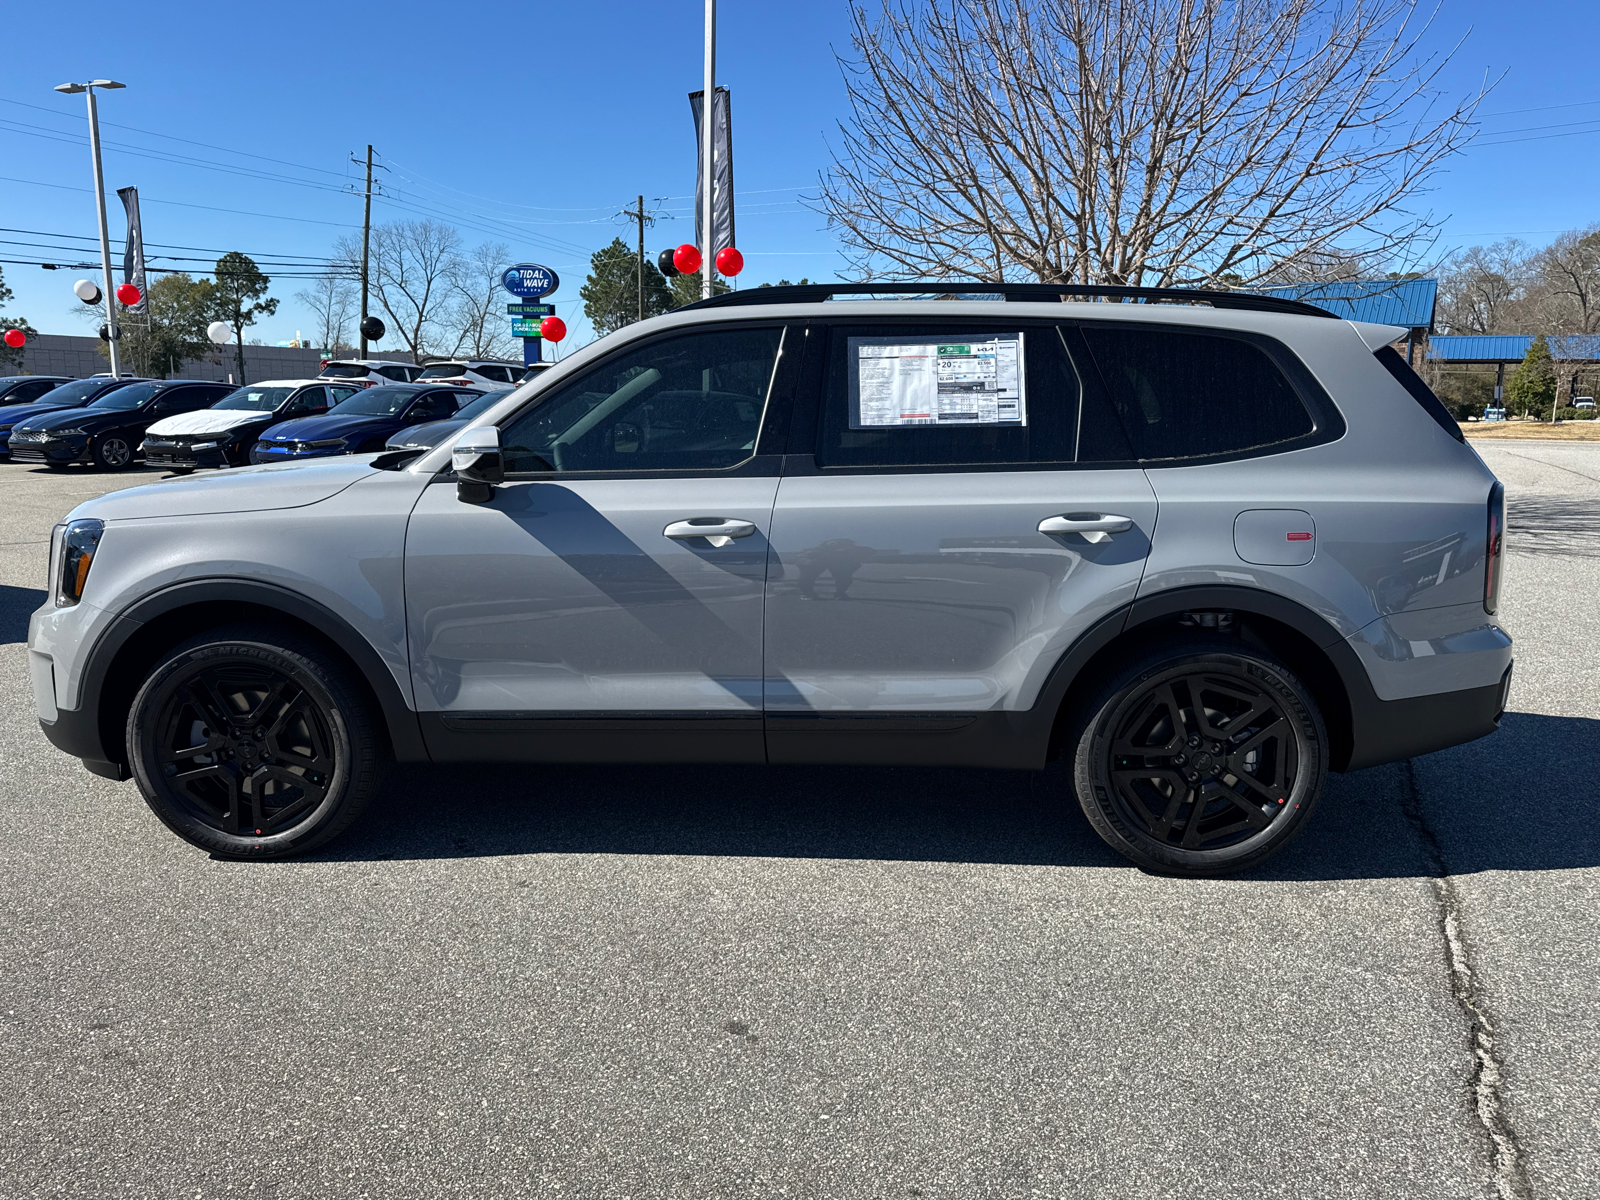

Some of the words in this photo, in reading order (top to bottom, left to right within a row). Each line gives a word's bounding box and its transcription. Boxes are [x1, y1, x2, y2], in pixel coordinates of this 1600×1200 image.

[520, 270, 544, 278] TIDAL
[524, 279, 549, 287] WAVE
[218, 646, 296, 674] MICHELIN
[1264, 674, 1316, 740] MICHELIN
[1096, 787, 1148, 852] MICHELIN
